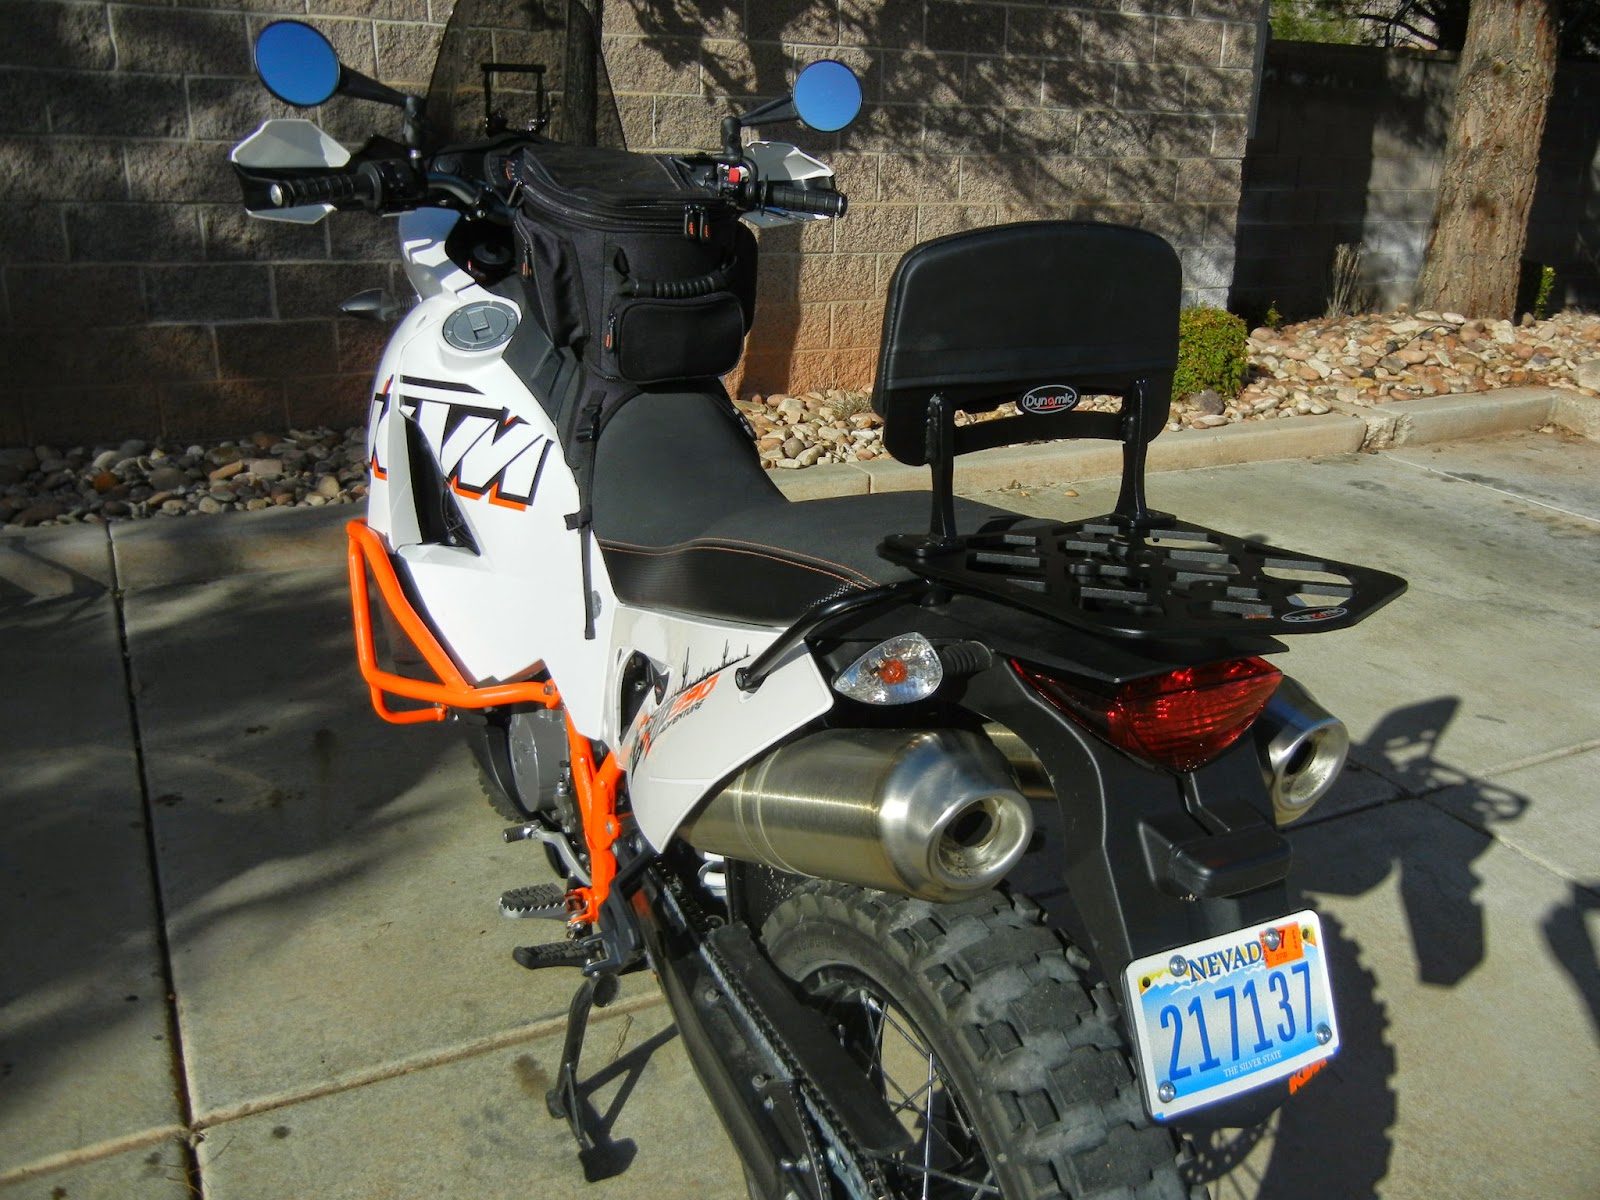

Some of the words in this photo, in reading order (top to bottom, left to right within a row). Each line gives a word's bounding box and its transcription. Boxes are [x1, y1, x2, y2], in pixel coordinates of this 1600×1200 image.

[1026, 393, 1073, 409] Dynamic
[368, 375, 555, 512] KTM
[1187, 940, 1265, 982] NEVAD
[1160, 961, 1313, 1081] 217137
[1223, 1065, 1239, 1077] THE
[1240, 1057, 1263, 1072] SILVER
[1263, 1050, 1282, 1064] STATE
